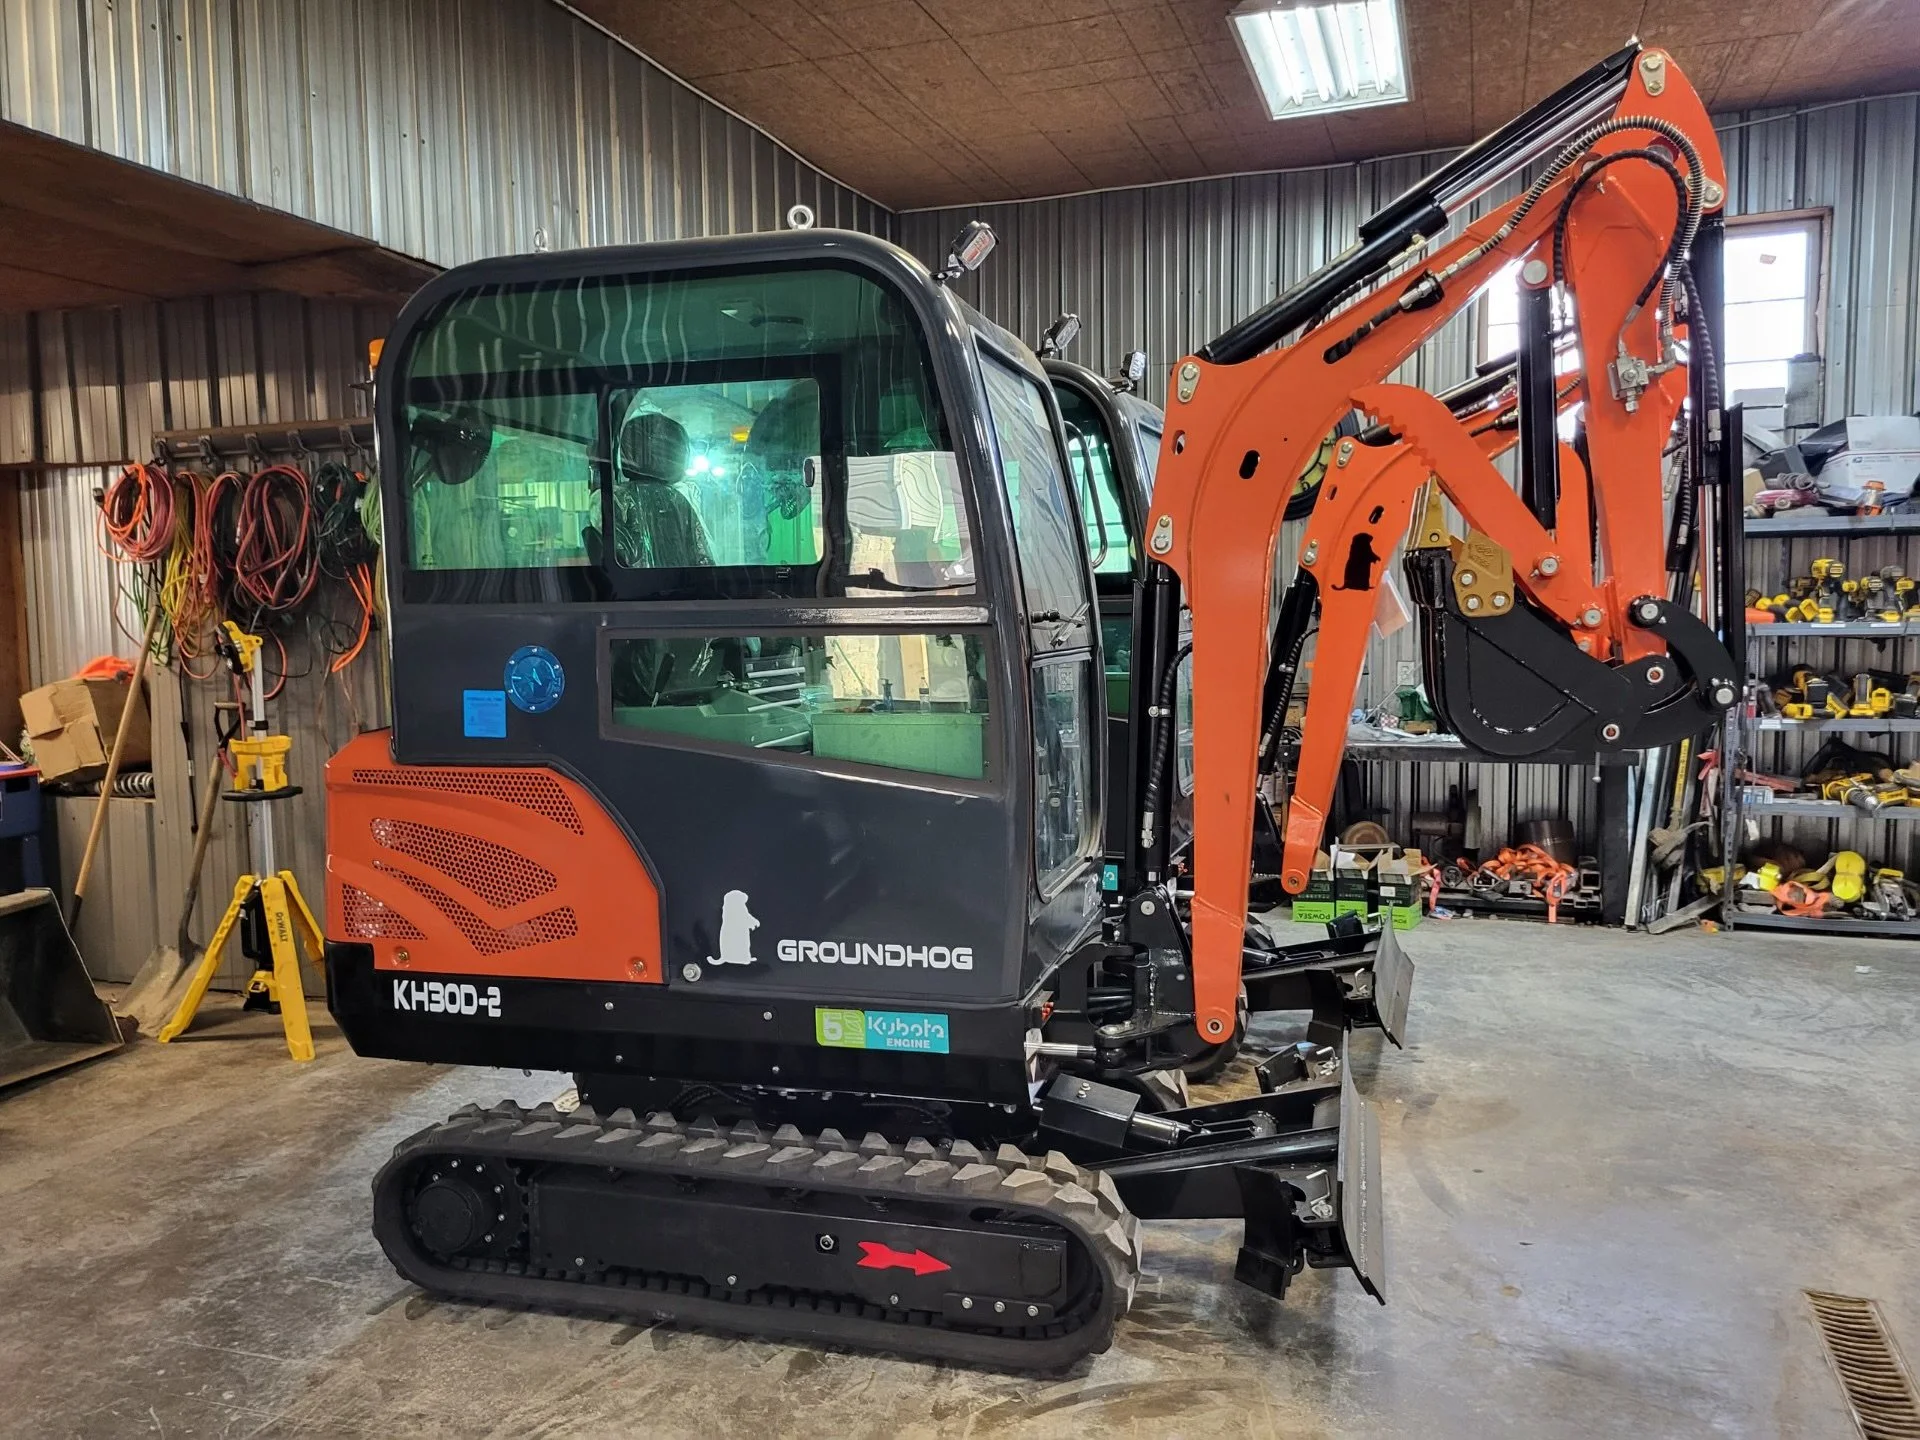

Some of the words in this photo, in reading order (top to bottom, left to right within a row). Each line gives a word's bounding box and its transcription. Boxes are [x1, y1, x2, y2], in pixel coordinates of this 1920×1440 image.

[777, 939, 973, 970] GROUNDHOG
[393, 979, 502, 1018] KH30D-2
[867, 1016, 945, 1039] Kubota
[886, 1038, 931, 1049] ENGINE
